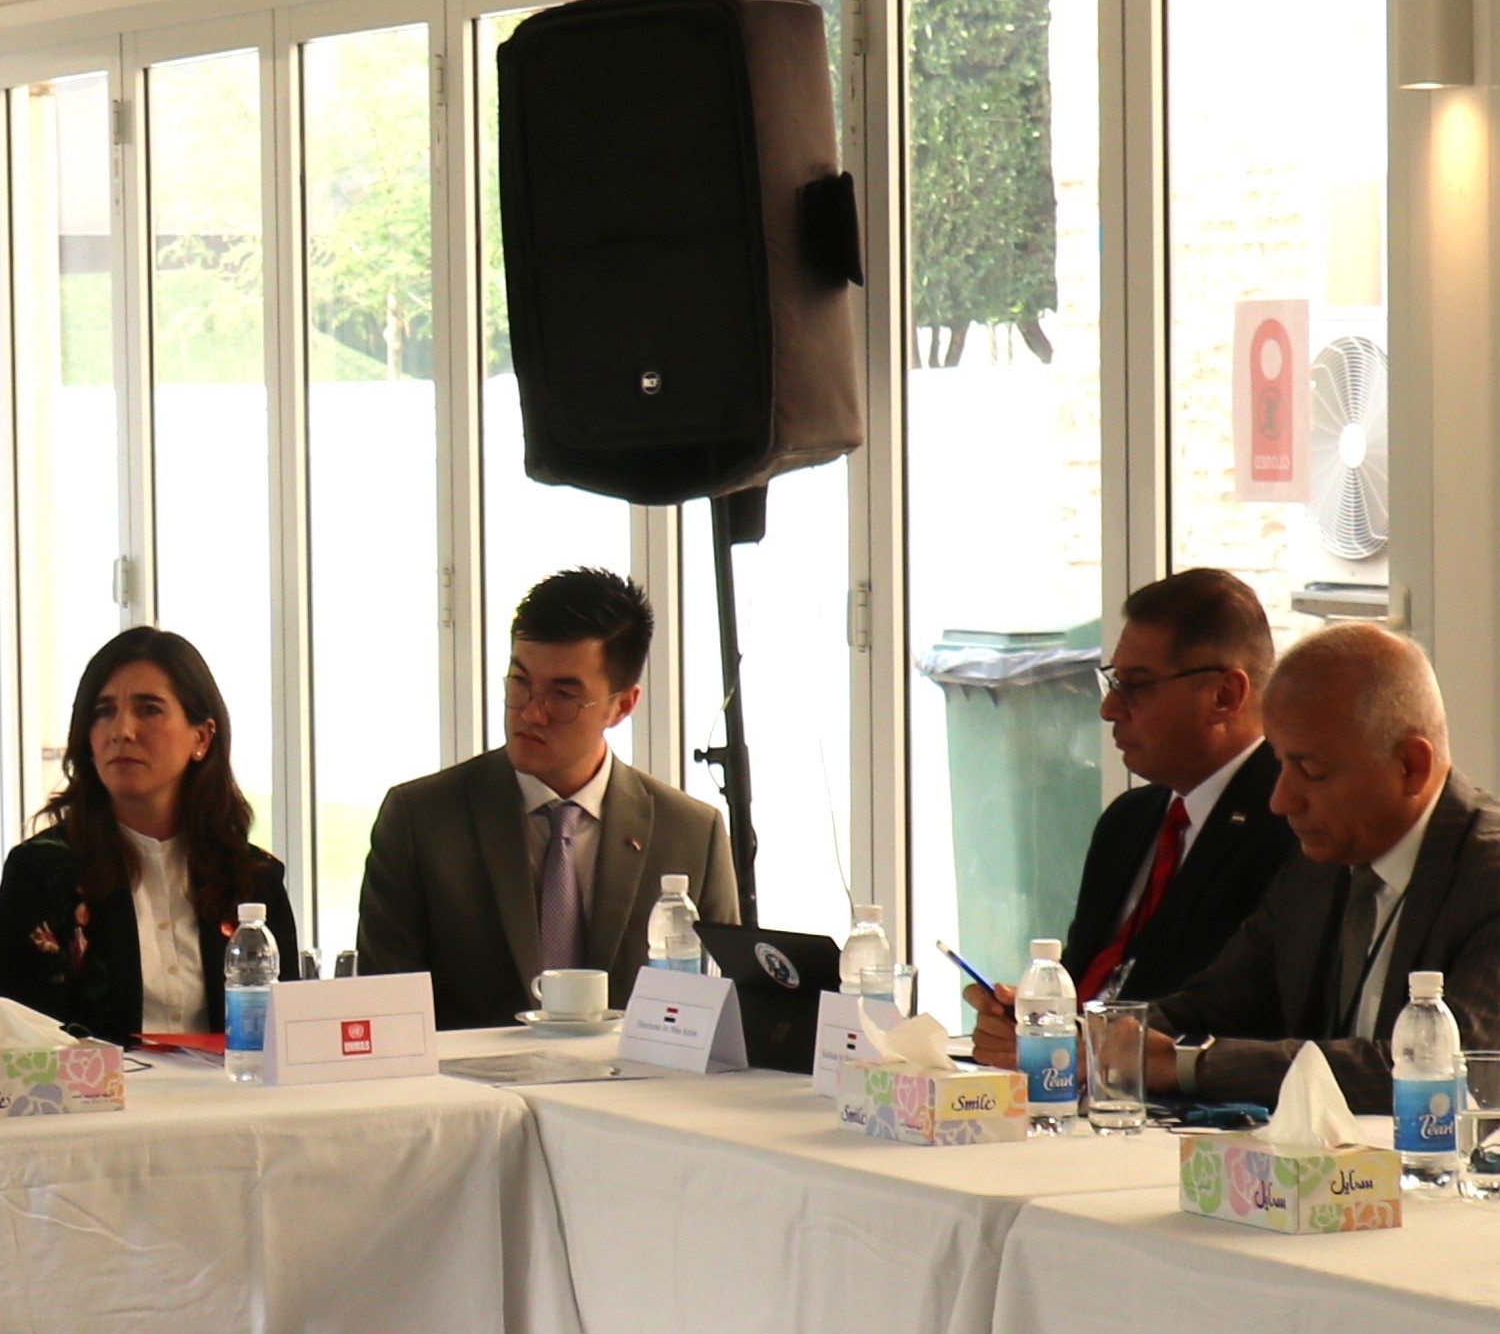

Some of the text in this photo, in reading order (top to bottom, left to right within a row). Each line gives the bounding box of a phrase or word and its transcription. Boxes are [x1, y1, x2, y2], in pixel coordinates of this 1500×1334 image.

[1041, 1067, 1074, 1091] Pearl
[951, 1093, 996, 1112] Smile
[1419, 1113, 1454, 1140] Pearl
[1330, 1170, 1374, 1195] سمايل
